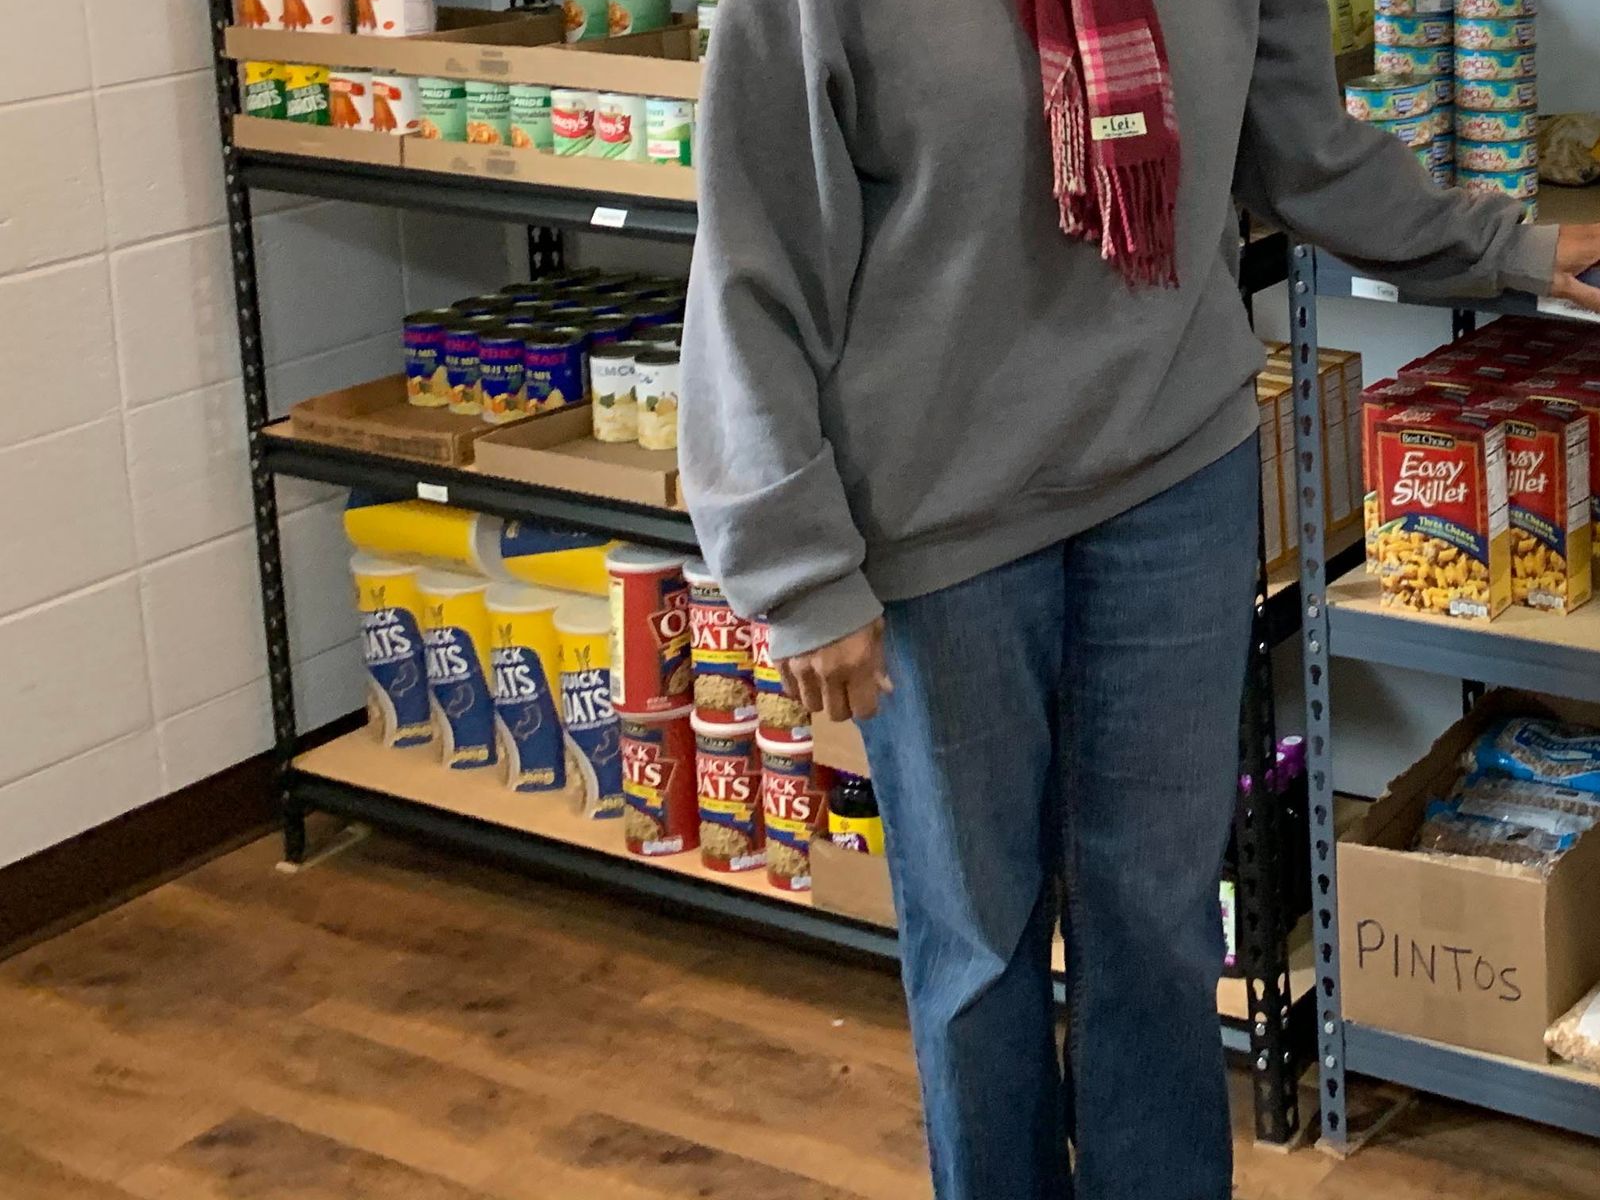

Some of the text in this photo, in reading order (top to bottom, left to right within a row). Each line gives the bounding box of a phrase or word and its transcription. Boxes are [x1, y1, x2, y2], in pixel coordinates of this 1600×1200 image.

[1400, 451, 1464, 483] Easy
[1391, 479, 1469, 508] Skillet
[1357, 920, 1521, 1001] PINTOS
